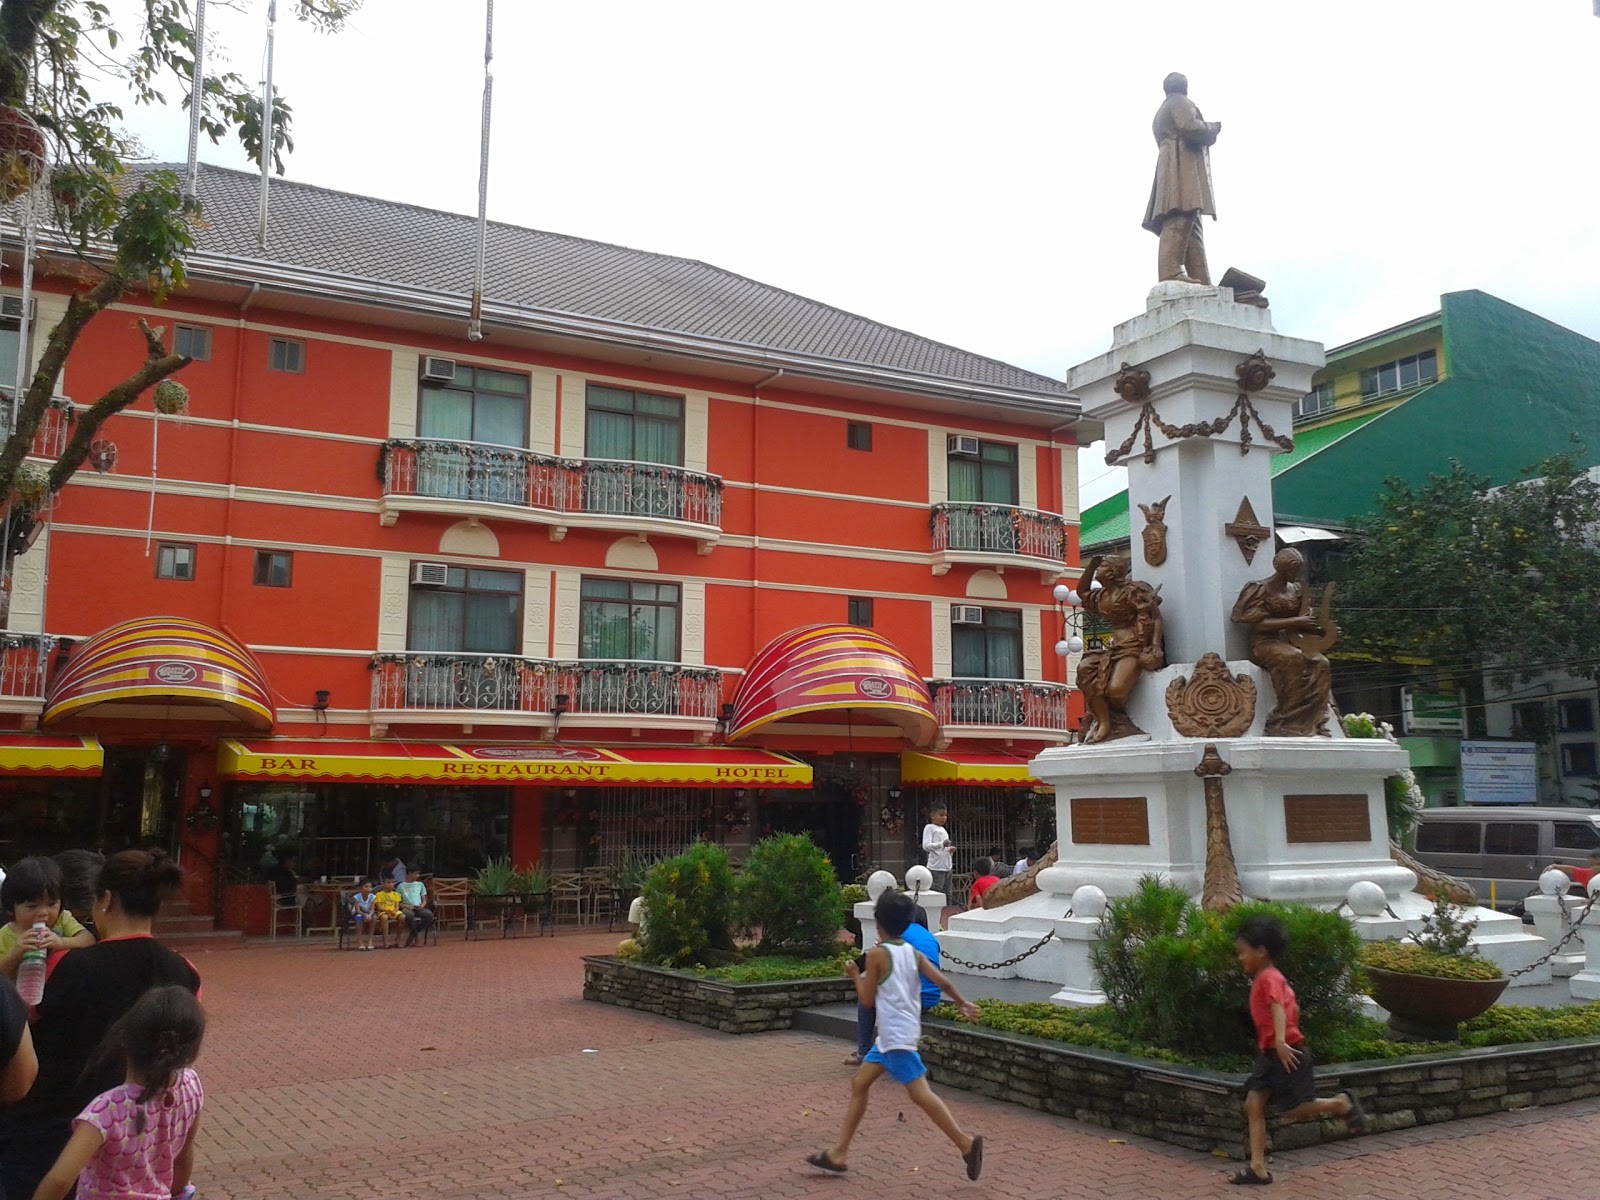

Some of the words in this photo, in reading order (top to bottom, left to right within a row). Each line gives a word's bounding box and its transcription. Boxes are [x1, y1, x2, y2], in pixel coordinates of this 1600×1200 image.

[260, 758, 318, 770] BAR
[442, 763, 609, 775] RESTAURANT
[716, 767, 789, 778] HOTEL
